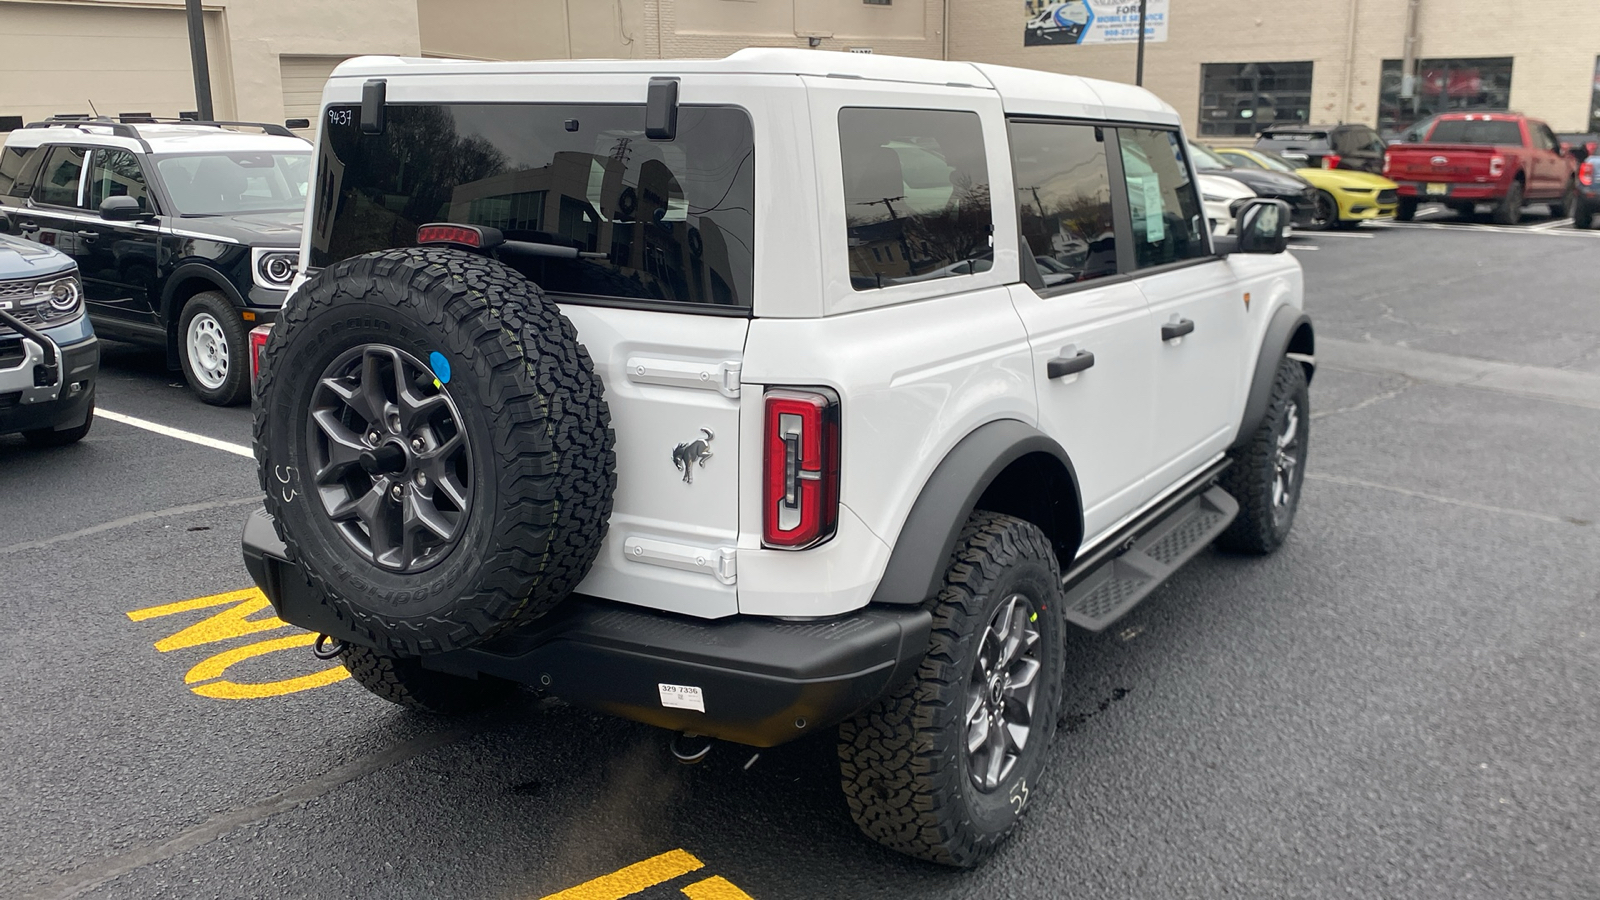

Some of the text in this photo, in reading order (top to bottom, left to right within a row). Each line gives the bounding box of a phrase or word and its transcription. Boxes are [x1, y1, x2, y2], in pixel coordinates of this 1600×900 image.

[1097, 12, 1164, 23] MOBILE SEVICE
[328, 109, 352, 127] 9437
[679, 687, 698, 695] 7336
[1009, 776, 1030, 815] 53
